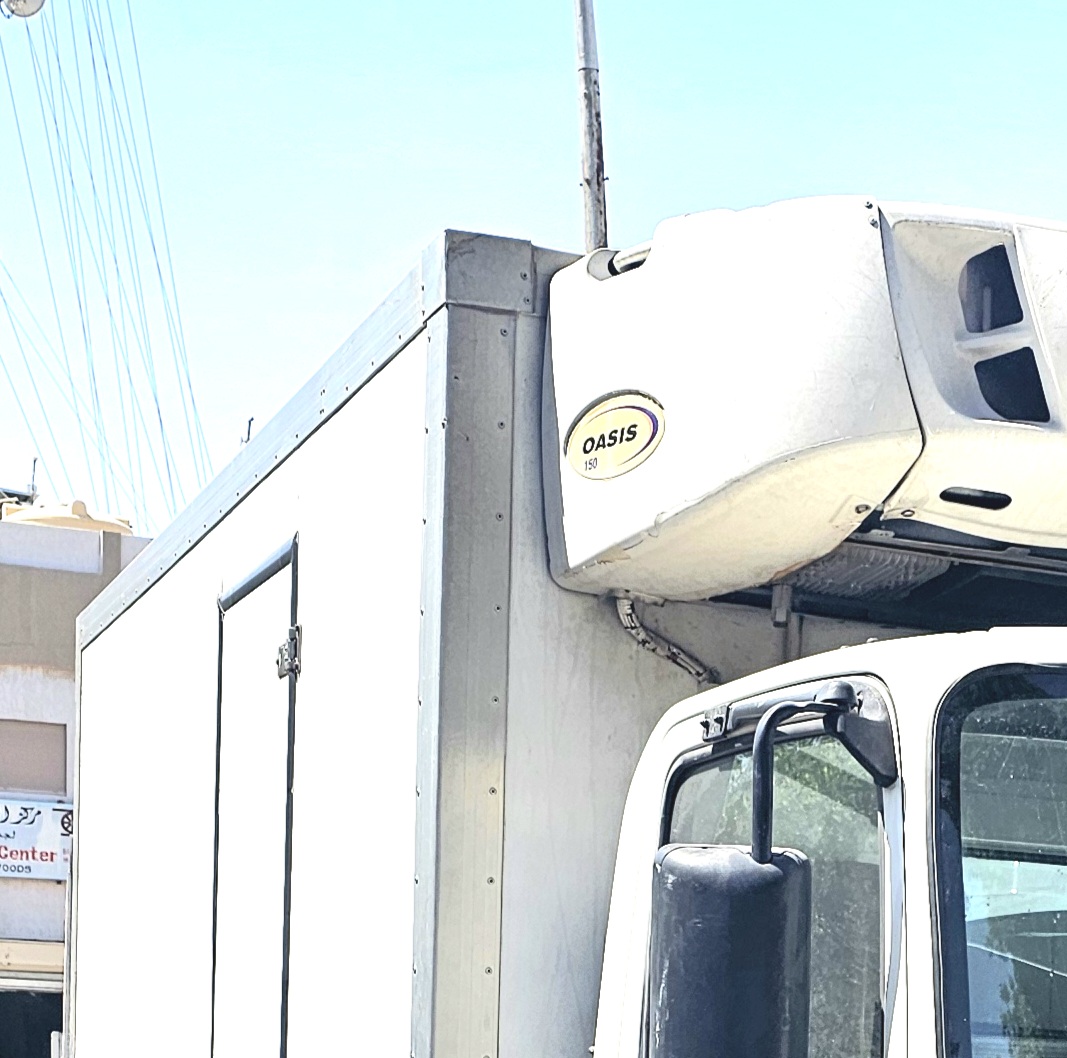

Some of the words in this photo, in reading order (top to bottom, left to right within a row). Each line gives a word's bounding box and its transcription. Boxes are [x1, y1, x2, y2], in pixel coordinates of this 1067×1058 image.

[582, 424, 638, 454] OASIS
[584, 457, 598, 471] 150
[0, 845, 57, 862] Center
[0, 863, 32, 874] OODS
